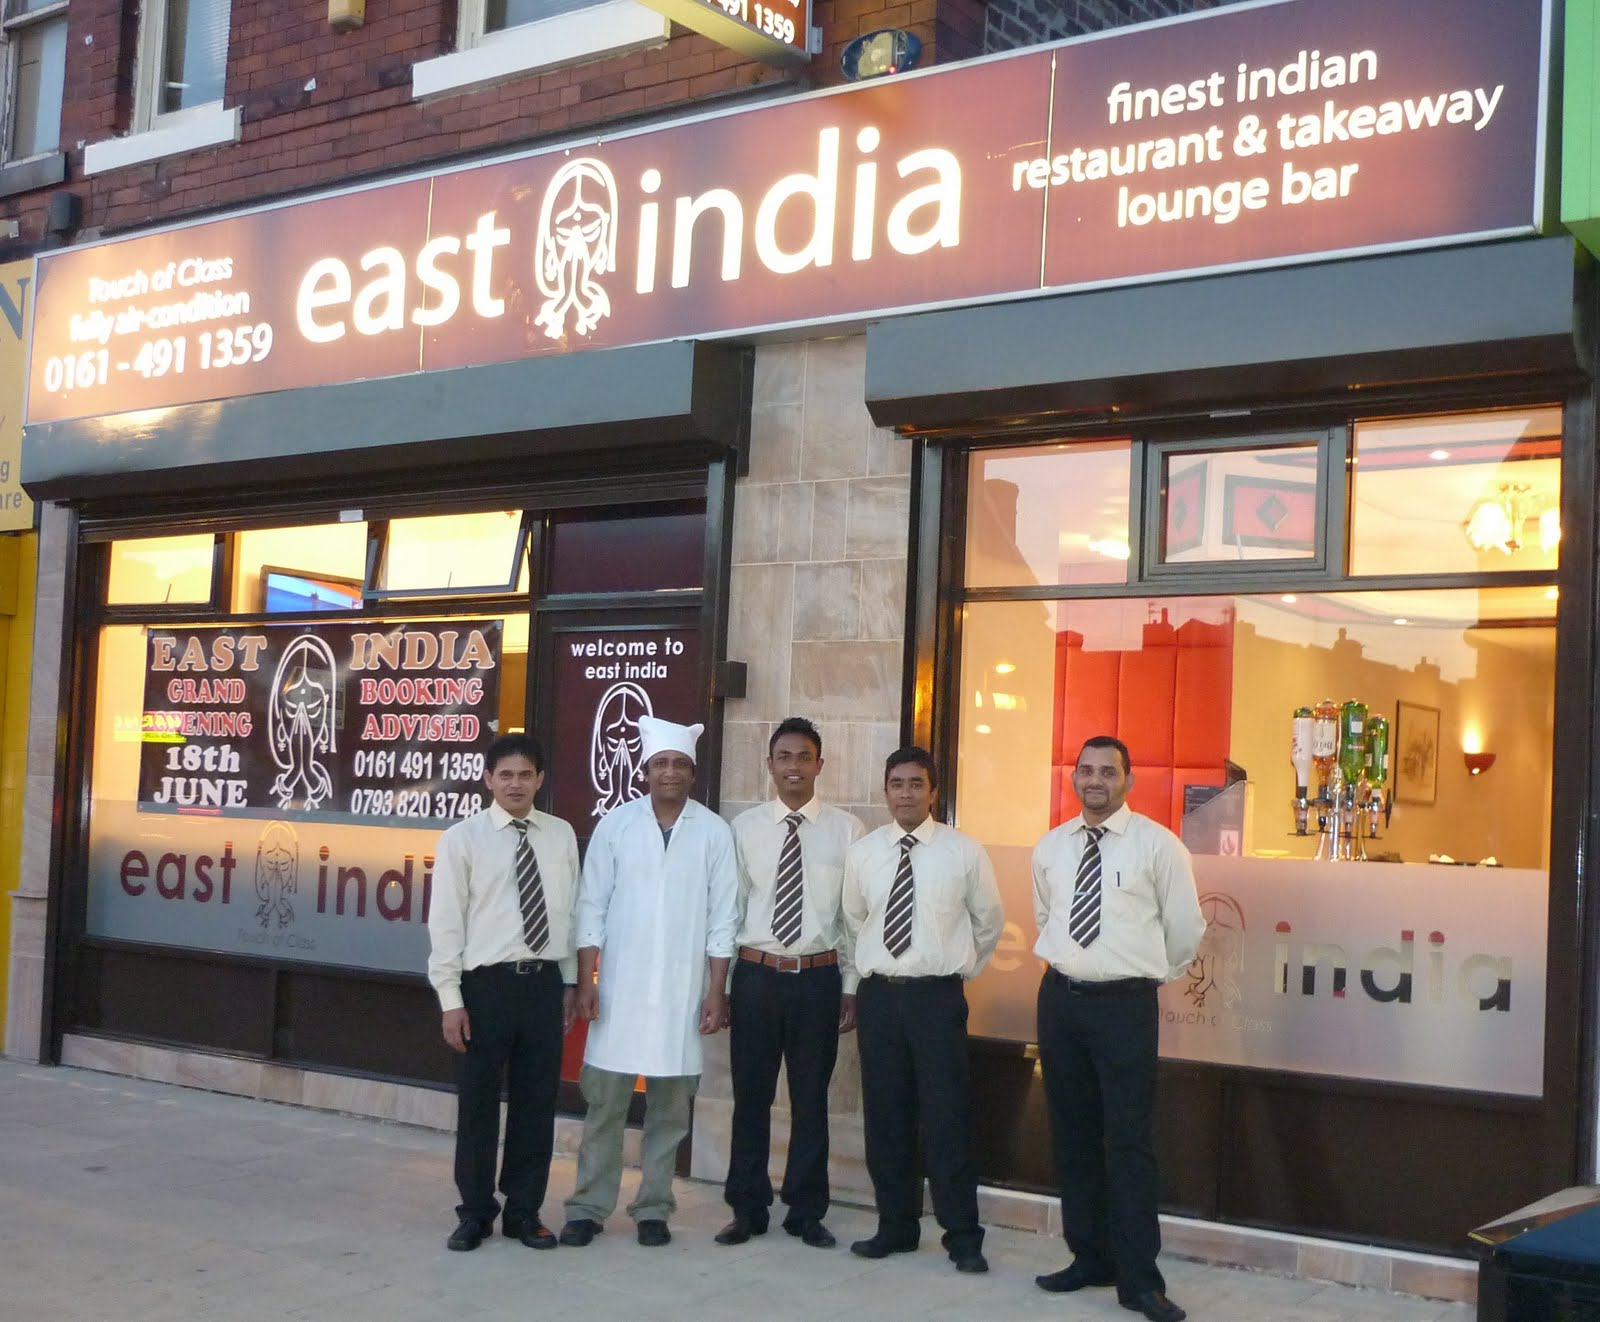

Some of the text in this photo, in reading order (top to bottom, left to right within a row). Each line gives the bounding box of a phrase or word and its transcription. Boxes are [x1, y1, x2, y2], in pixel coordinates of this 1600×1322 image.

[754, 3, 795, 44] 1359
[1107, 49, 1377, 124] finest indian
[1012, 84, 1504, 191] restaurant & takeaway
[1117, 160, 1359, 228] lounge bar
[297, 126, 962, 343] east india
[88, 257, 233, 303] Touch of Class
[69, 289, 250, 345] fully air-condition
[44, 349, 109, 392] 0161
[133, 336, 186, 378] 491
[199, 323, 273, 369] 1359
[151, 630, 495, 672] EAST INDIA
[571, 637, 684, 656] welcome to
[168, 678, 246, 703] GRAND
[585, 662, 668, 679] east india
[360, 678, 483, 705] BOOKING
[362, 713, 480, 742] ADVISED
[166, 744, 240, 772] 18th
[354, 750, 485, 781] 0161 491 1359
[153, 777, 248, 808] JUNE
[351, 788, 482, 818] 0793 820 3748
[120, 841, 435, 923] east indi
[1274, 921, 1512, 1011] india
